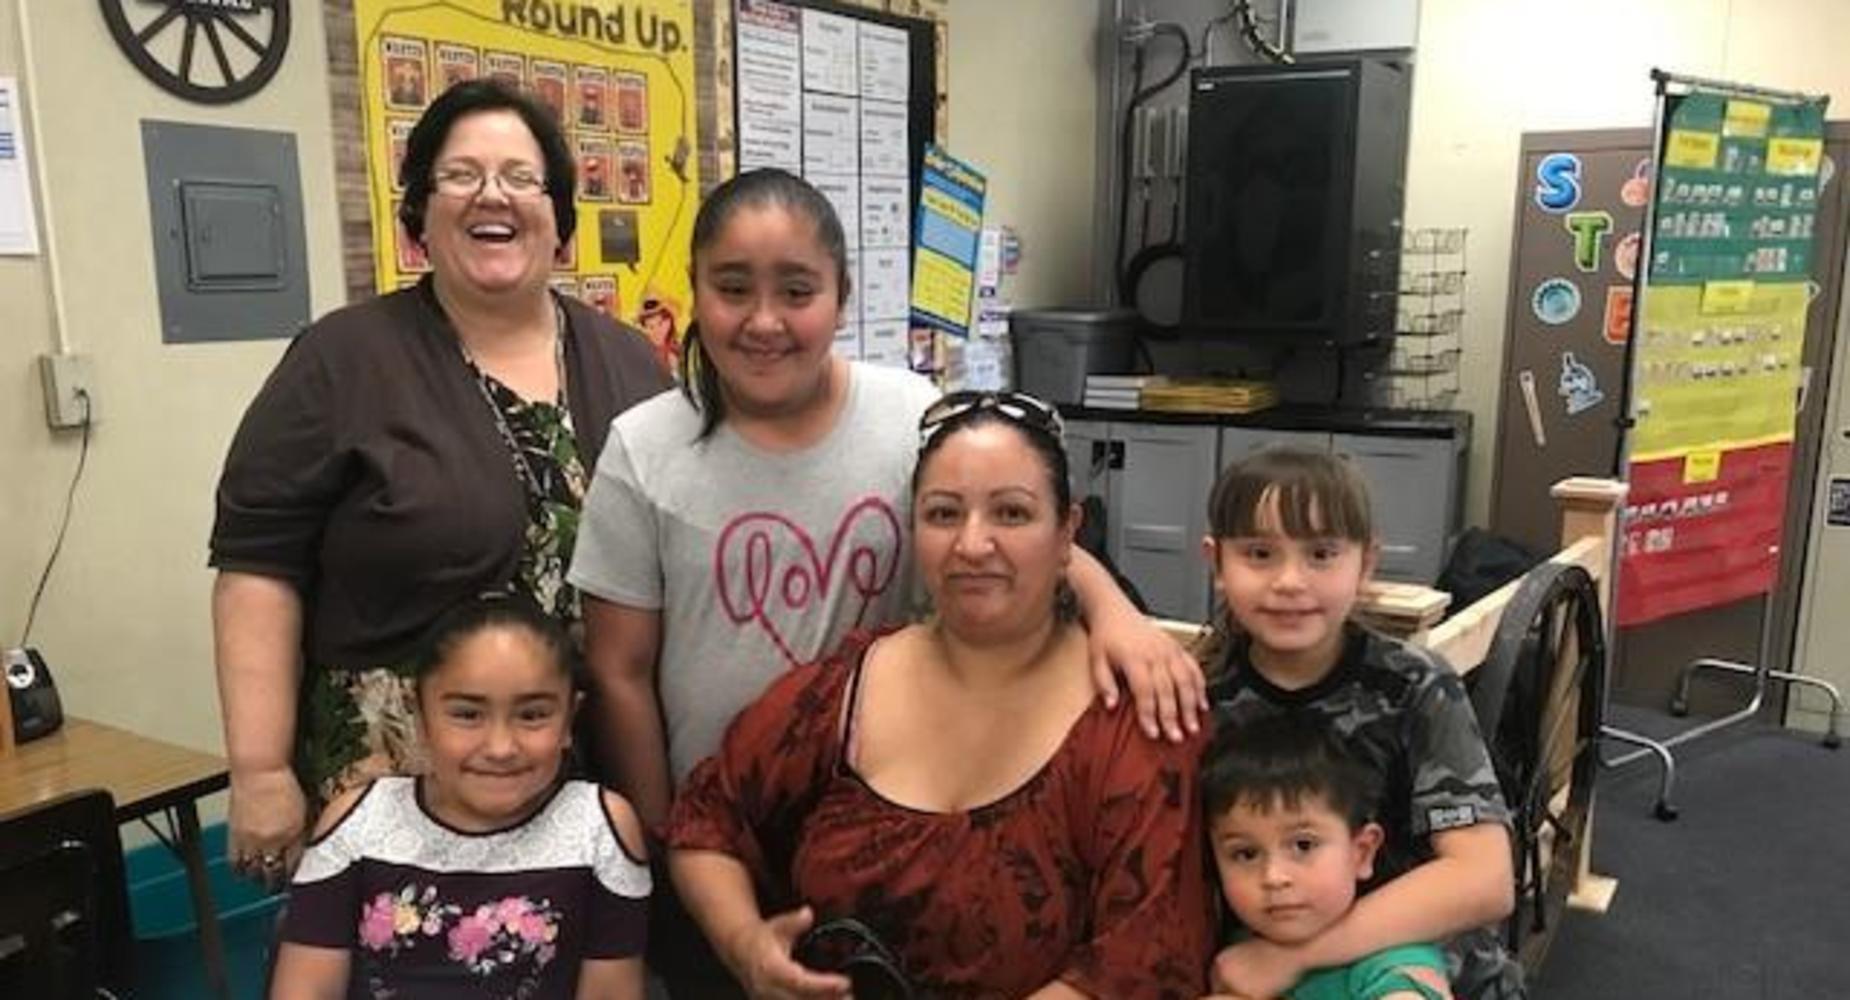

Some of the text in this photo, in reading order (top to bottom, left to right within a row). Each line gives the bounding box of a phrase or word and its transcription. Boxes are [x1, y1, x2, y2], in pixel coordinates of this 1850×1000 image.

[501, 0, 626, 44] Round
[635, 6, 688, 53] Up.
[1536, 153, 1582, 212] S
[1565, 211, 1614, 272] T
[715, 497, 902, 665] love
